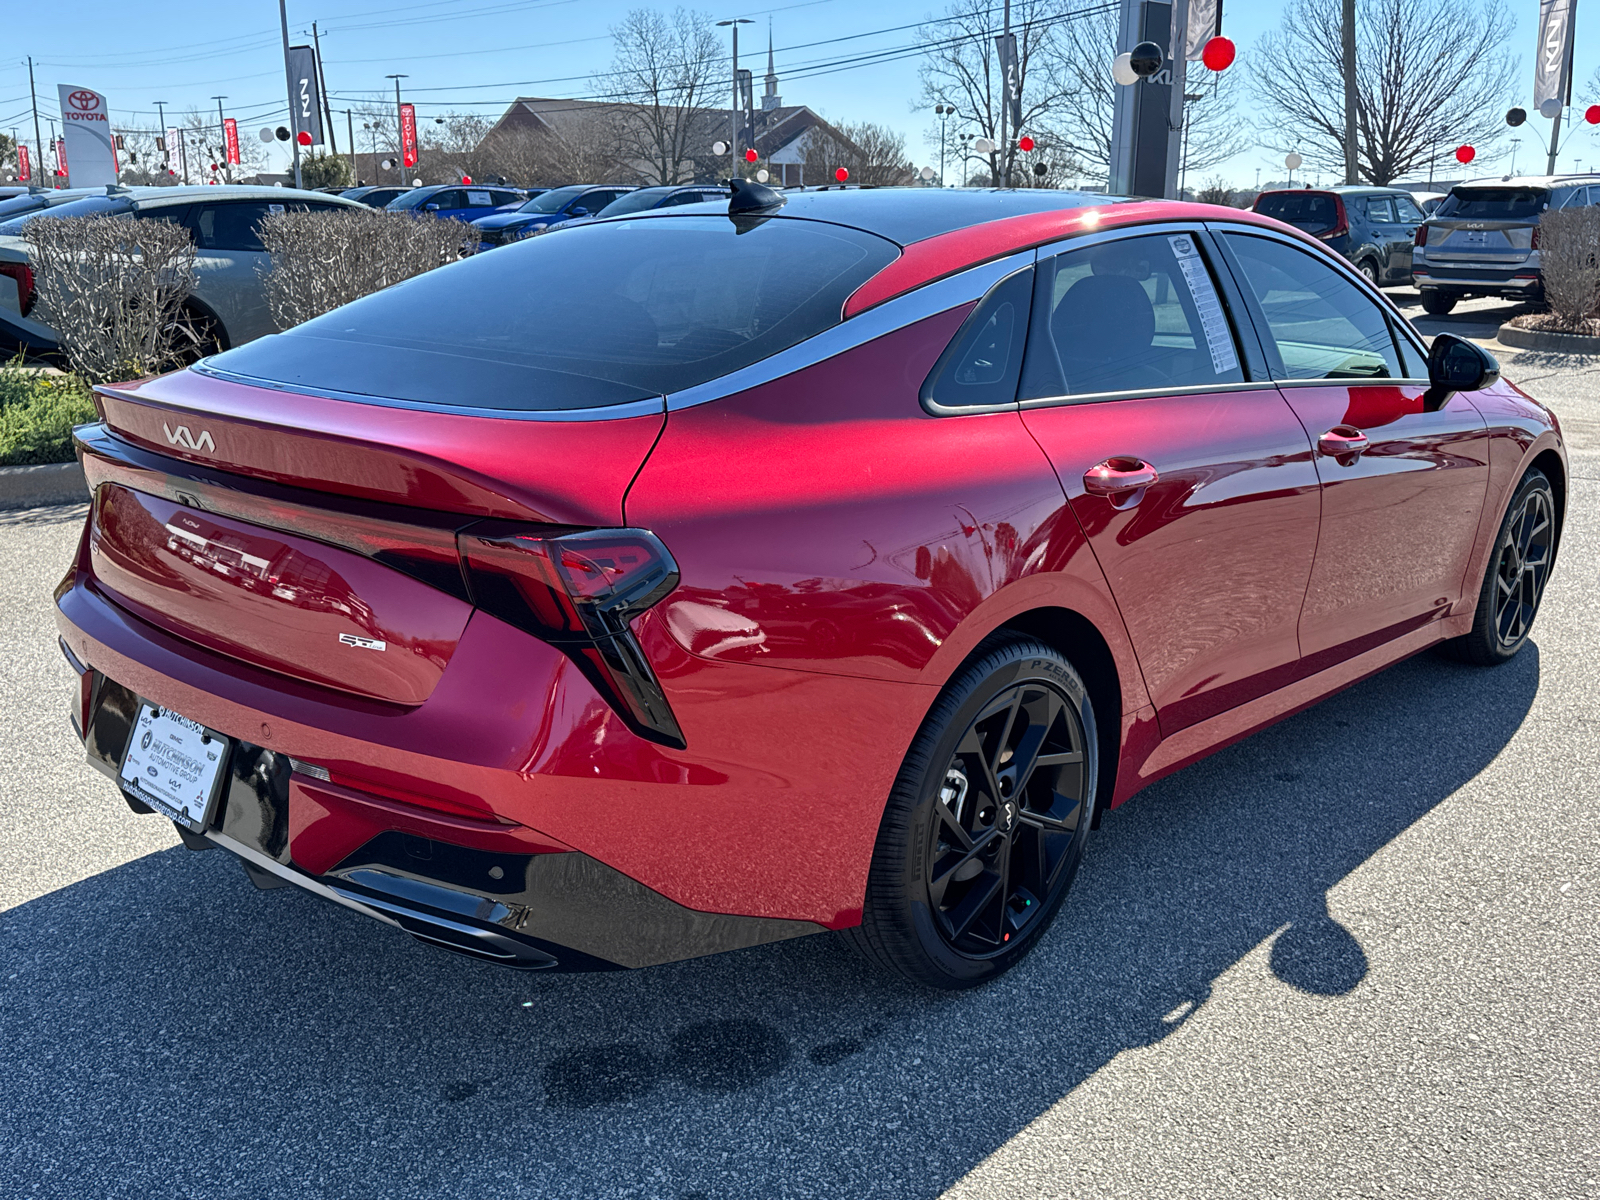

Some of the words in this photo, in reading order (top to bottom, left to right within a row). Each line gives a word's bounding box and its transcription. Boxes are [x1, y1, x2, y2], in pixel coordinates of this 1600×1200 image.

[64, 111, 107, 122] TOYOTA
[404, 116, 414, 162] TOYOTA
[163, 421, 216, 453] KIA
[1030, 660, 1042, 670] P
[1042, 660, 1079, 691] ZERO
[165, 708, 205, 735] HUTCHINSON
[148, 752, 179, 776] AUTOMOTIVE
[178, 768, 198, 784] GROUP
[150, 739, 206, 778] HUTCHINSON
